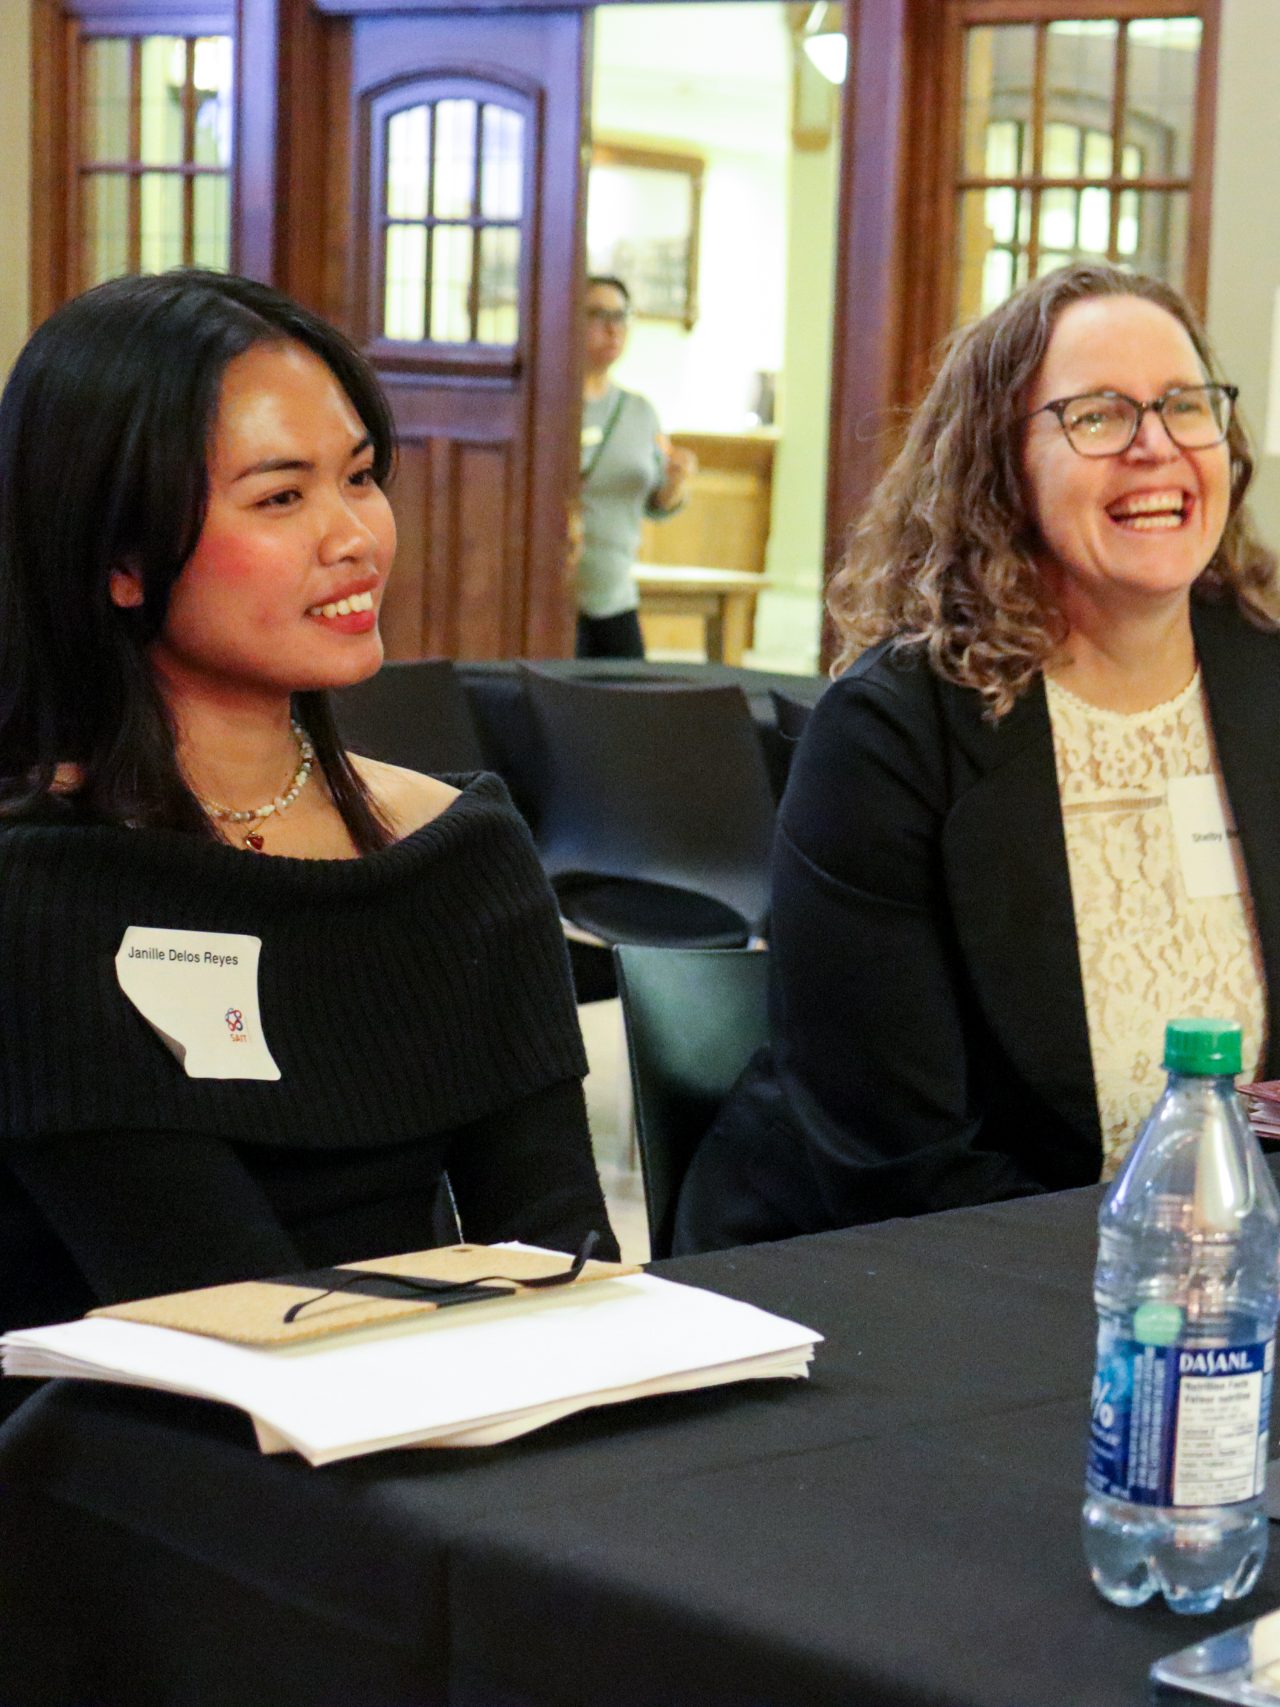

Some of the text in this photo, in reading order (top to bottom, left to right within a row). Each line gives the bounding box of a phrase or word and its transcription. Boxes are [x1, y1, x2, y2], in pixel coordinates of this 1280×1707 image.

[128, 946, 239, 967] Janille Delos Reyes
[229, 1033, 247, 1043] SAIT
